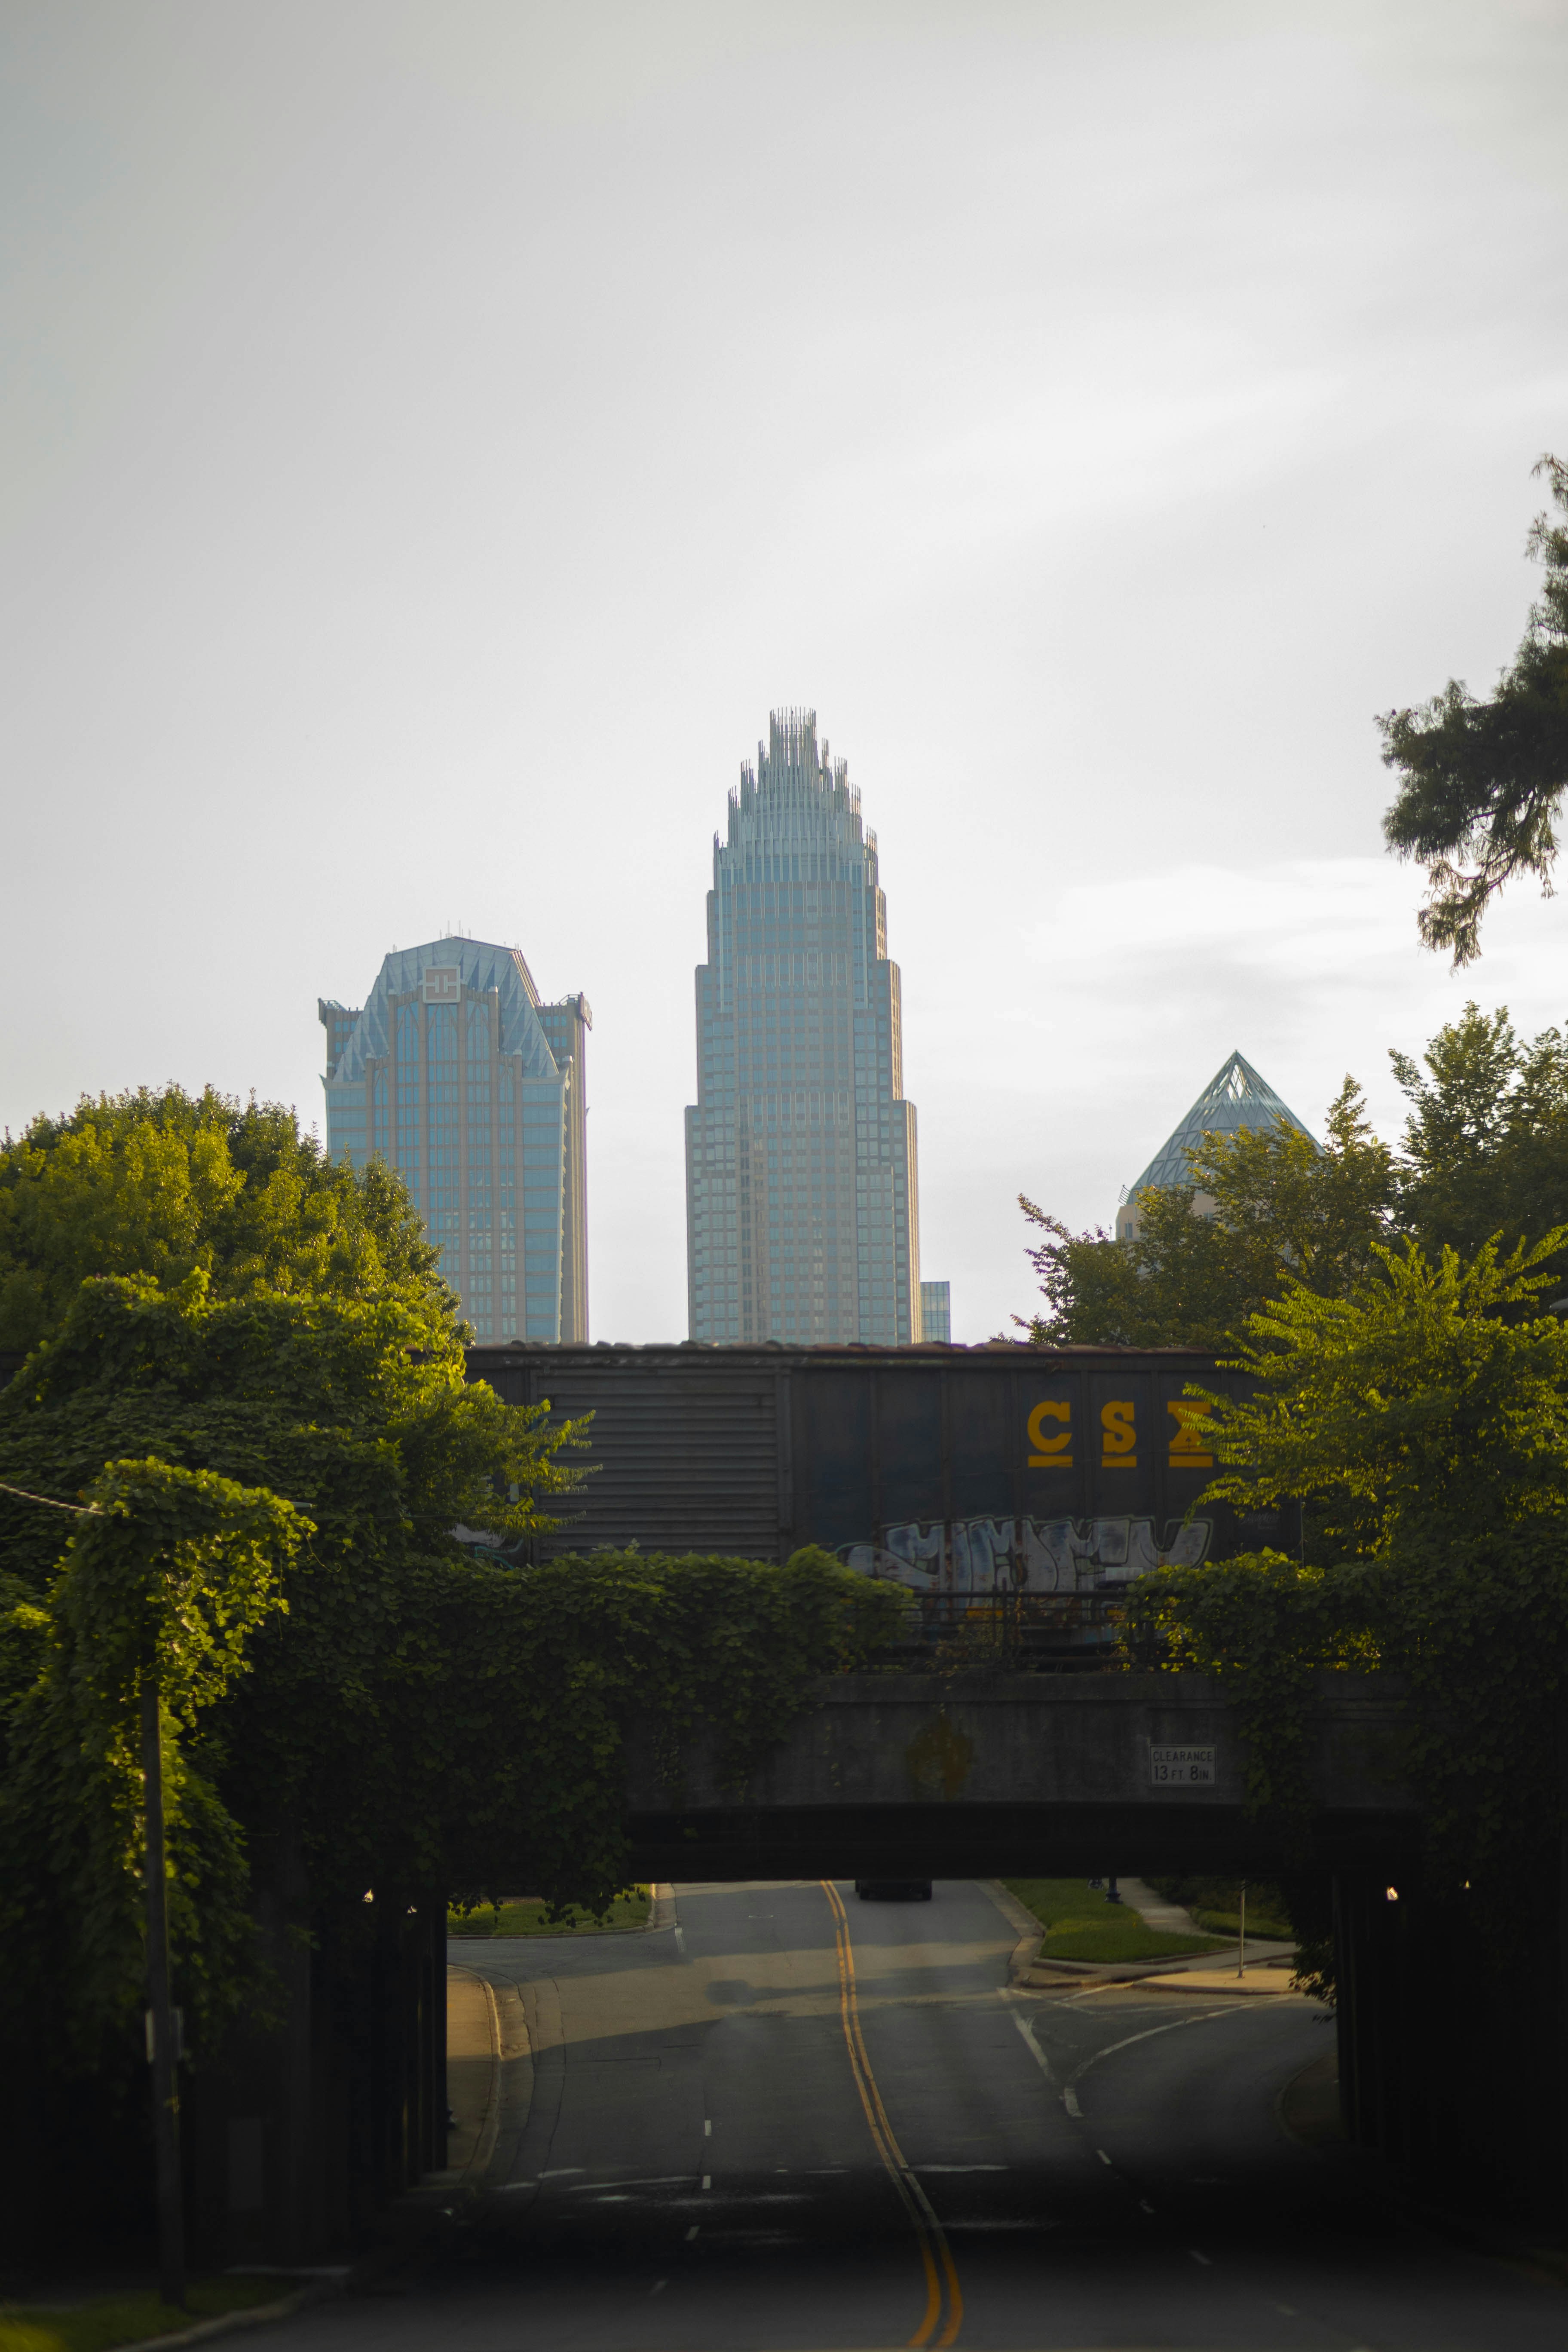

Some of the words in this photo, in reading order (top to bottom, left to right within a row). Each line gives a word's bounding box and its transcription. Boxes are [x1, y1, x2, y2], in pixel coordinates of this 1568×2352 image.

[1027, 1401, 1211, 1453] CSX
[1153, 1751, 1213, 1761] CLEARANCE
[1155, 1765, 1167, 1780] 13
